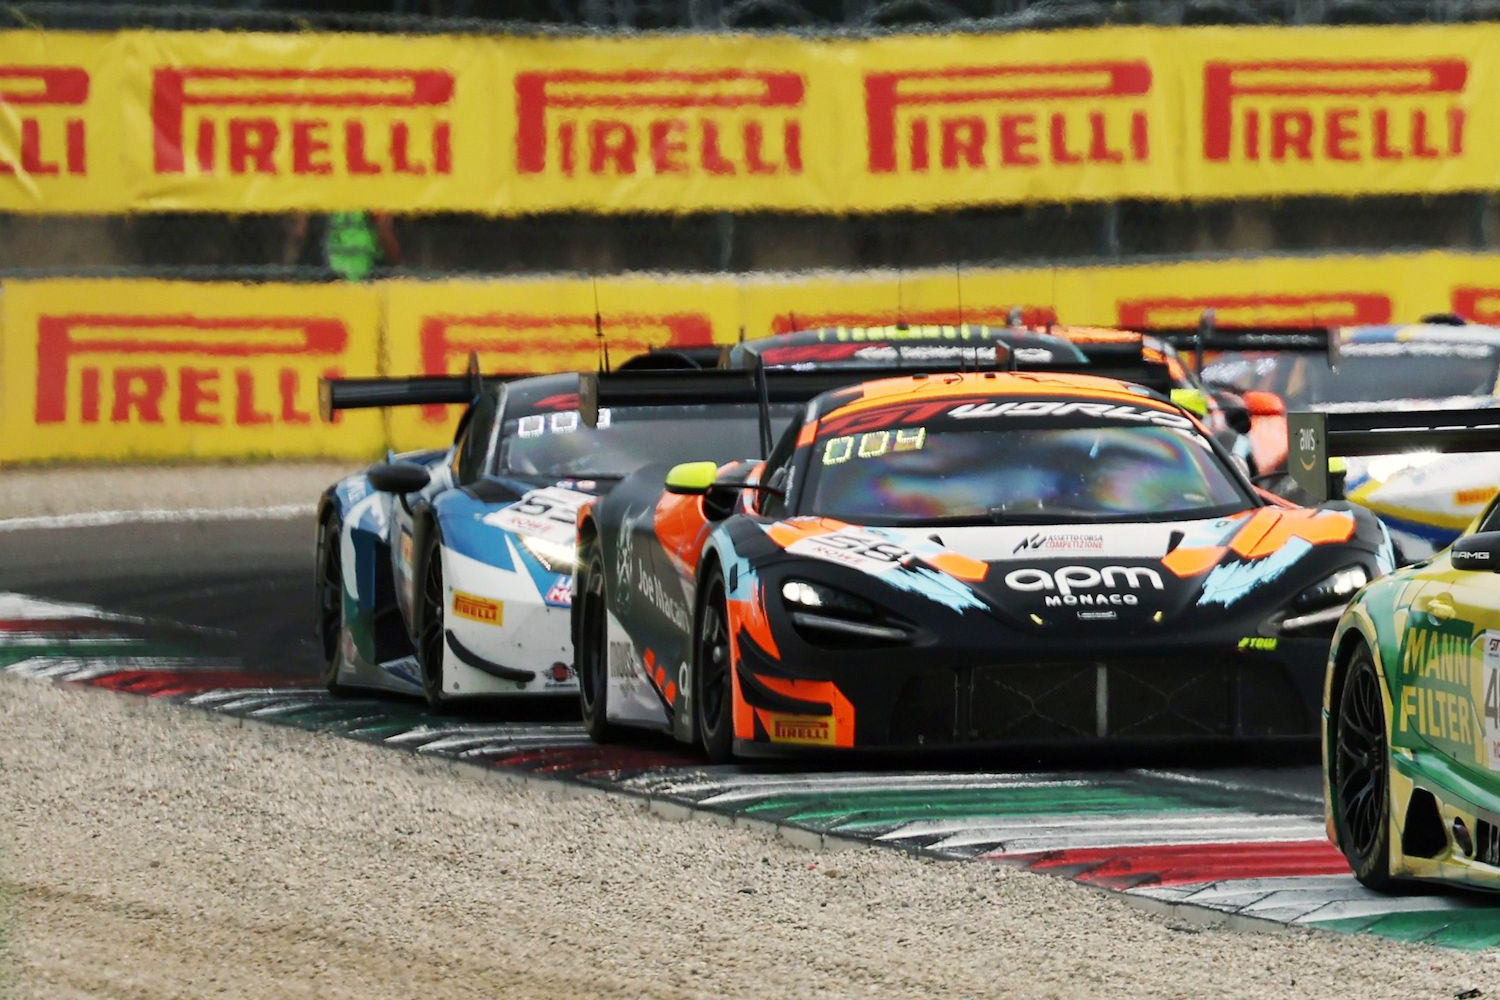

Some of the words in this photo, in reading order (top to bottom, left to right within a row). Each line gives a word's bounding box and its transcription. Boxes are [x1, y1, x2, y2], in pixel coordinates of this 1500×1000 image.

[151, 66, 455, 175] PIRELLI
[514, 68, 805, 175] PIRELLI
[863, 60, 1152, 174] PIRELLI
[1203, 59, 1468, 163] PIRELLI
[822, 427, 926, 466] 004
[1004, 565, 1165, 597] apm
[1458, 551, 1490, 560] AMG
[1044, 593, 1139, 607] MONACO
[1402, 626, 1469, 688] MANN
[1400, 685, 1473, 745] FILTER
